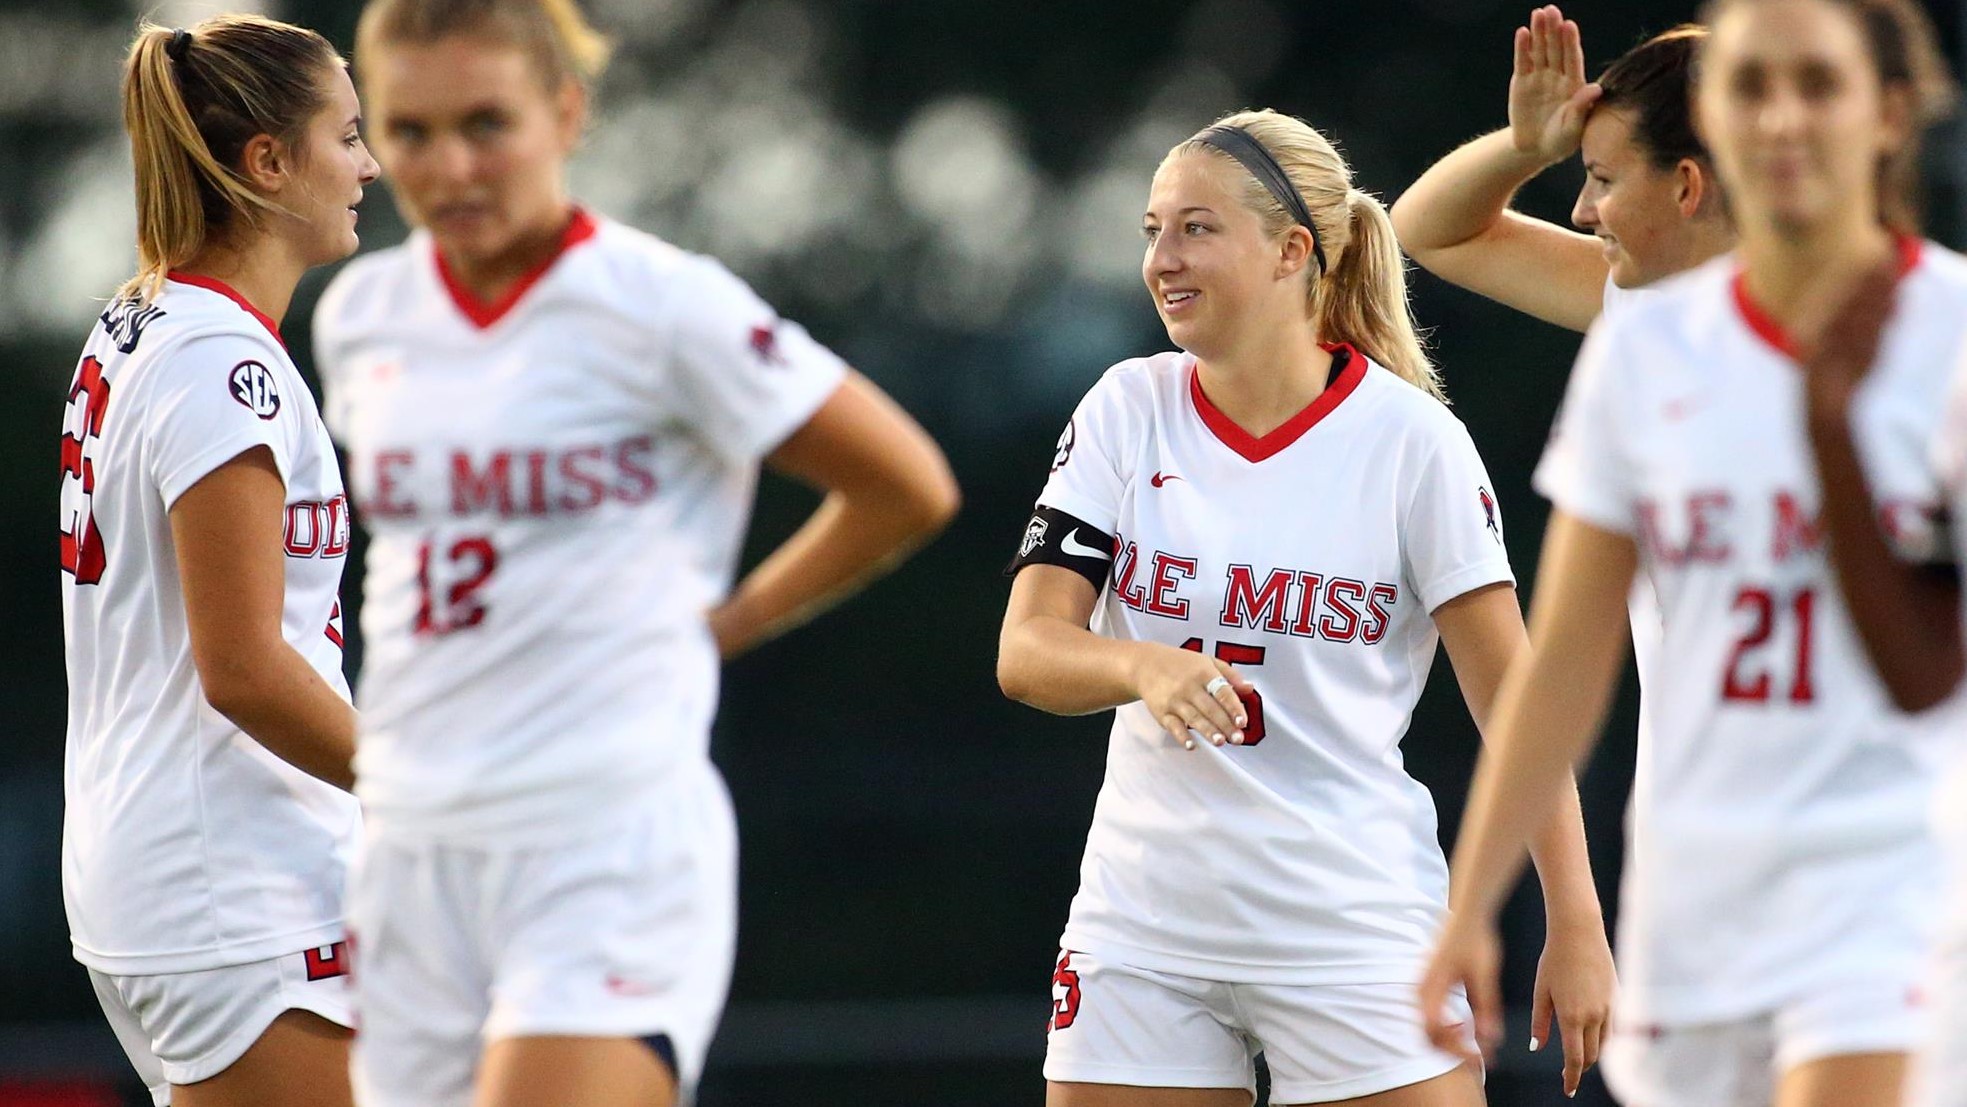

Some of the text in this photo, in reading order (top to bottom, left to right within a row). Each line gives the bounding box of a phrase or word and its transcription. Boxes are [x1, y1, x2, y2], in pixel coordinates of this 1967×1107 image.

[231, 362, 280, 417] SEC
[448, 434, 658, 520] MISS
[283, 494, 350, 558] OL
[412, 535, 500, 640] 12
[1219, 563, 1398, 645] MISS
[1720, 583, 1815, 705] 21
[1180, 636, 1267, 746] 5
